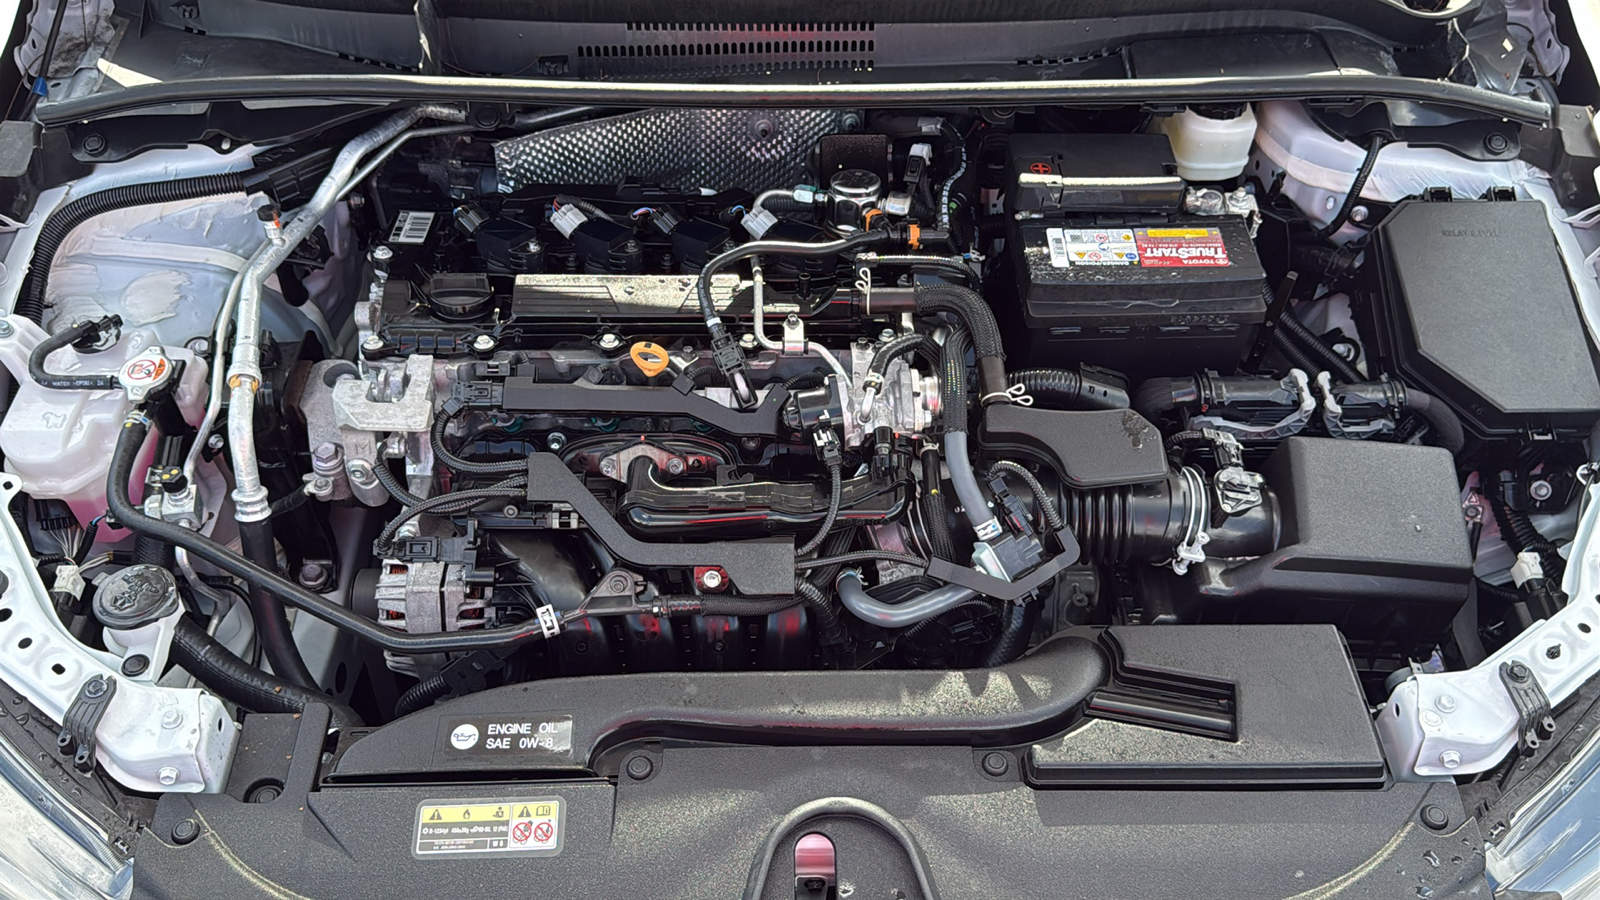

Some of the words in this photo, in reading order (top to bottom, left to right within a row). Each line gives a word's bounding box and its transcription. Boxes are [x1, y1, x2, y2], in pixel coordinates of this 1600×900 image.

[1441, 229, 1467, 237] RELAY
[487, 722, 532, 735] ENGINE
[538, 722, 559, 734] OIL
[485, 737, 511, 749] SAE
[518, 737, 554, 749] 0W-8
